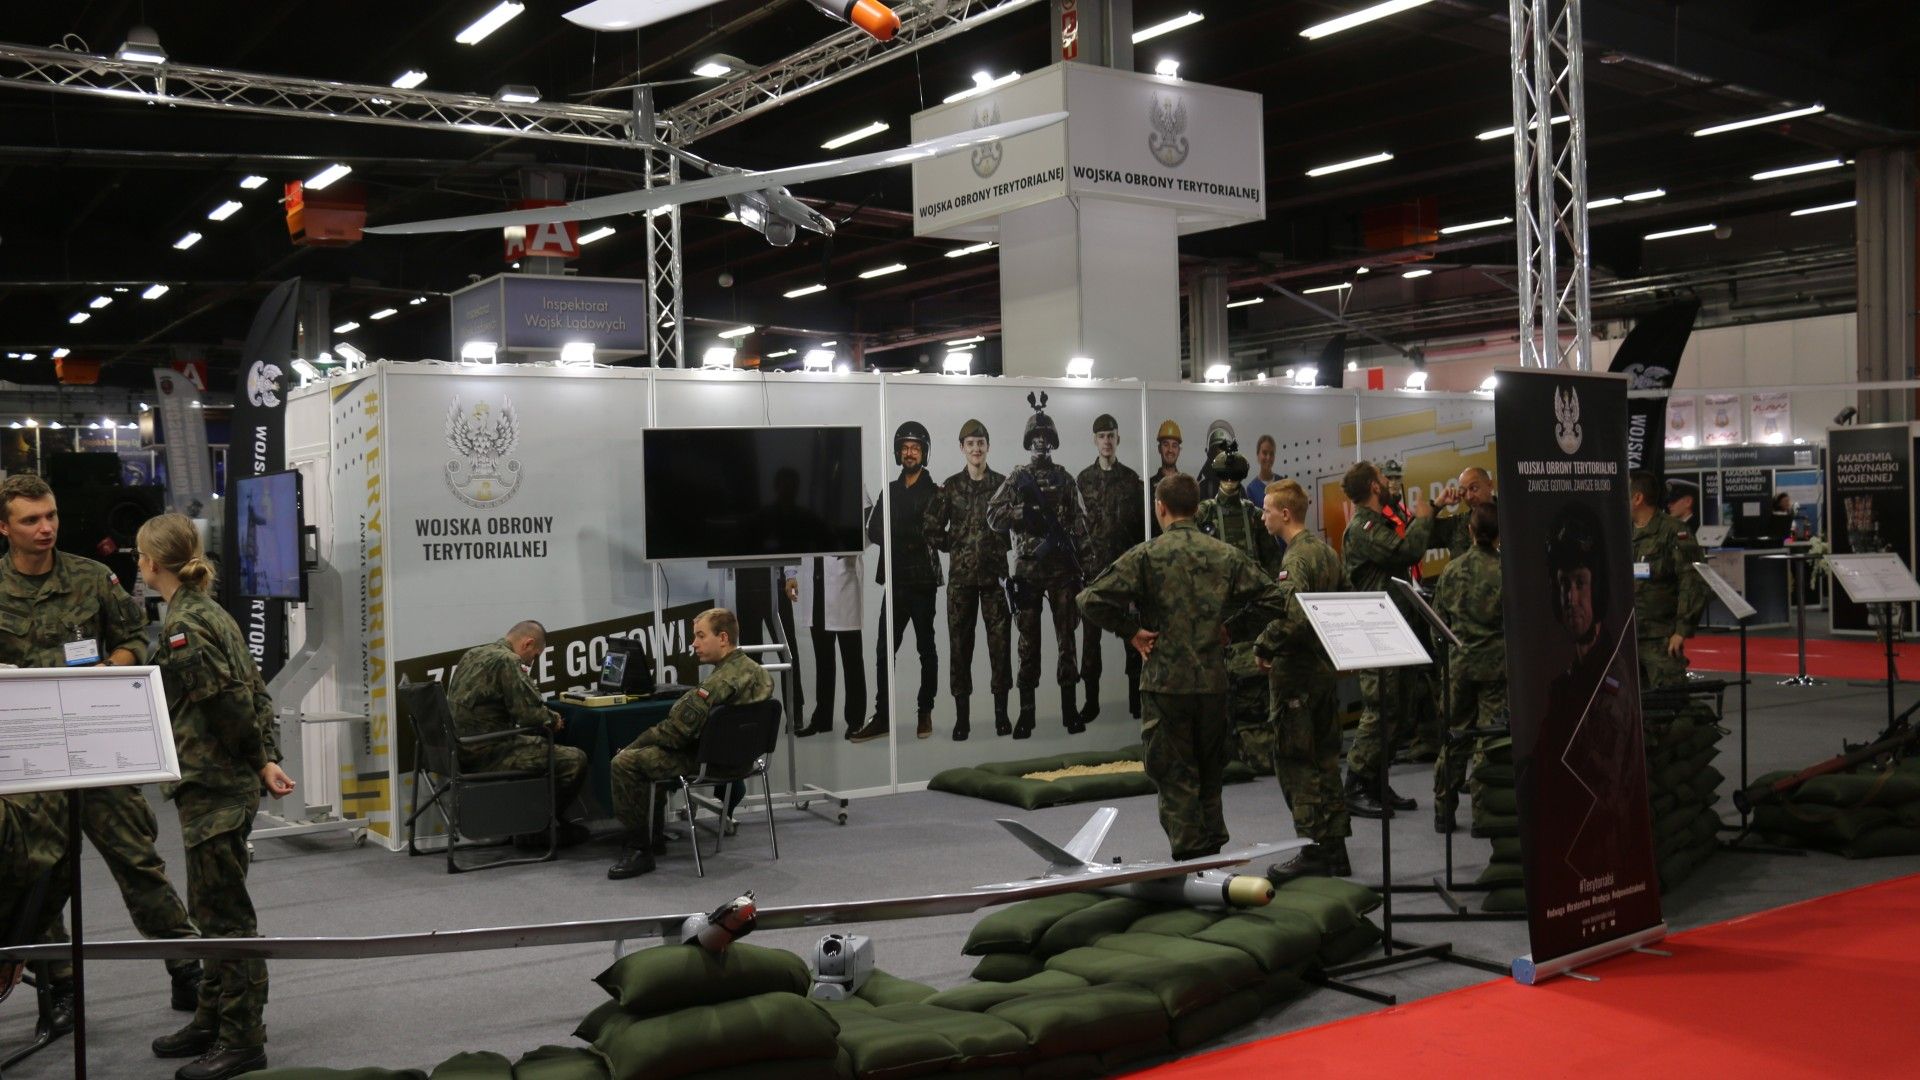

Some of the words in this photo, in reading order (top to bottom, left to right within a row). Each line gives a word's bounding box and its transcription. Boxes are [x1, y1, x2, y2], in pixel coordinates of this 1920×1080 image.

[919, 200, 953, 218] WOJSKA
[954, 188, 991, 208] OBRONY
[993, 167, 1064, 197] TERYTORIALNEJ
[1073, 166, 1122, 183] WOJSKA
[1124, 172, 1174, 189] OBRONY
[1176, 179, 1260, 202] TERYTORIALNEJ
[543, 297, 609, 313] Inspektorat
[525, 313, 563, 332] Wojsk
[566, 315, 627, 333] Lądowych
[254, 426, 267, 475] WOJS
[1628, 414, 1647, 469] WOJSKA
[1517, 460, 1546, 475] WOJSKA
[1546, 460, 1573, 475] OBRONY
[1573, 460, 1618, 475] TERYTORIALNEJ
[1837, 452, 1892, 463] AKADEMIA
[1837, 463, 1899, 473] MARYNARKI
[1725, 476, 1766, 484] MARYNARKI
[1725, 484, 1762, 492] WOJENNEJ
[1838, 473, 1893, 484] WOJENNEJ
[416, 518, 482, 536] WOJSKA
[487, 516, 553, 535] OBRONY
[423, 541, 548, 561] TERYTORIALNEJ
[364, 390, 389, 756] #TERYTORIALSI
